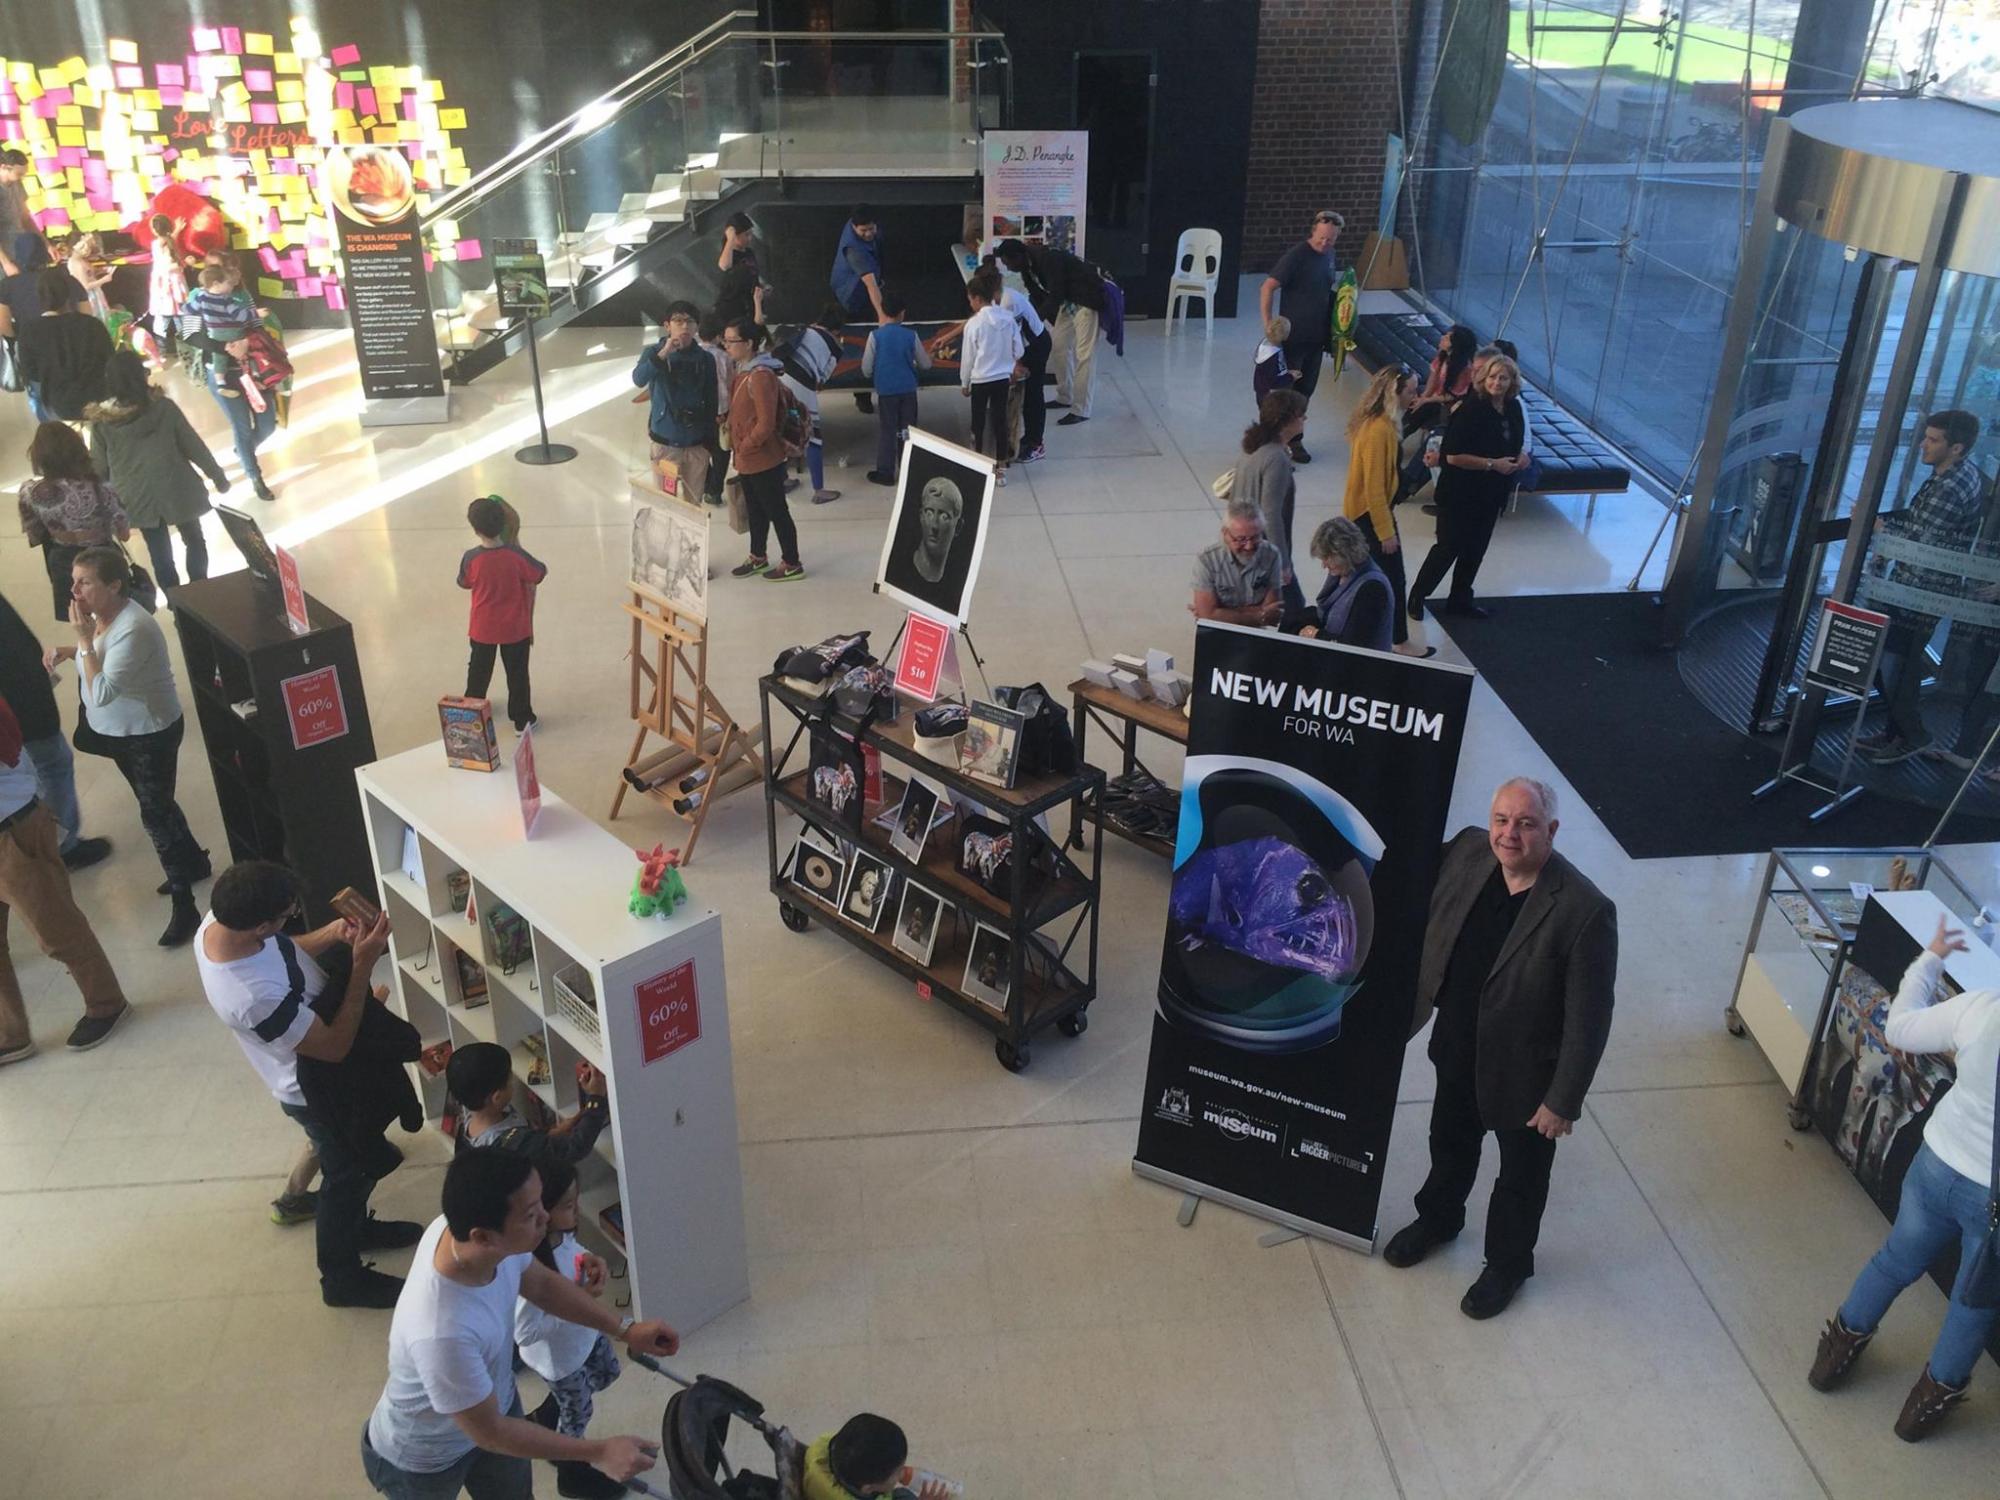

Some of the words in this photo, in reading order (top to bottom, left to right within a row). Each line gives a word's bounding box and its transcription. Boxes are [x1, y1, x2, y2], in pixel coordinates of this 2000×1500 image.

[172, 112, 228, 138] Love
[229, 124, 317, 153] Letters
[1002, 145, 1028, 163] J.D.
[1033, 145, 1074, 165] Penangke
[346, 234, 362, 242] THE
[377, 233, 412, 241] MUSEUM
[347, 244, 355, 252] IS
[356, 243, 398, 251] CHANGING
[1851, 626, 1876, 637] ACCESS
[911, 666, 926, 679] $10
[299, 696, 332, 717] 60%
[1210, 668, 1288, 708] NEW
[1294, 684, 1444, 742] MUSEUM
[312, 720, 326, 730] Off
[1284, 716, 1320, 738] FOR
[1325, 724, 1355, 745] WA
[649, 995, 688, 1026] 60%
[664, 1025, 680, 1040] Off
[1188, 1065, 1347, 1121] museum.wa.gov.au/new-museum
[1203, 1110, 1277, 1143] museum
